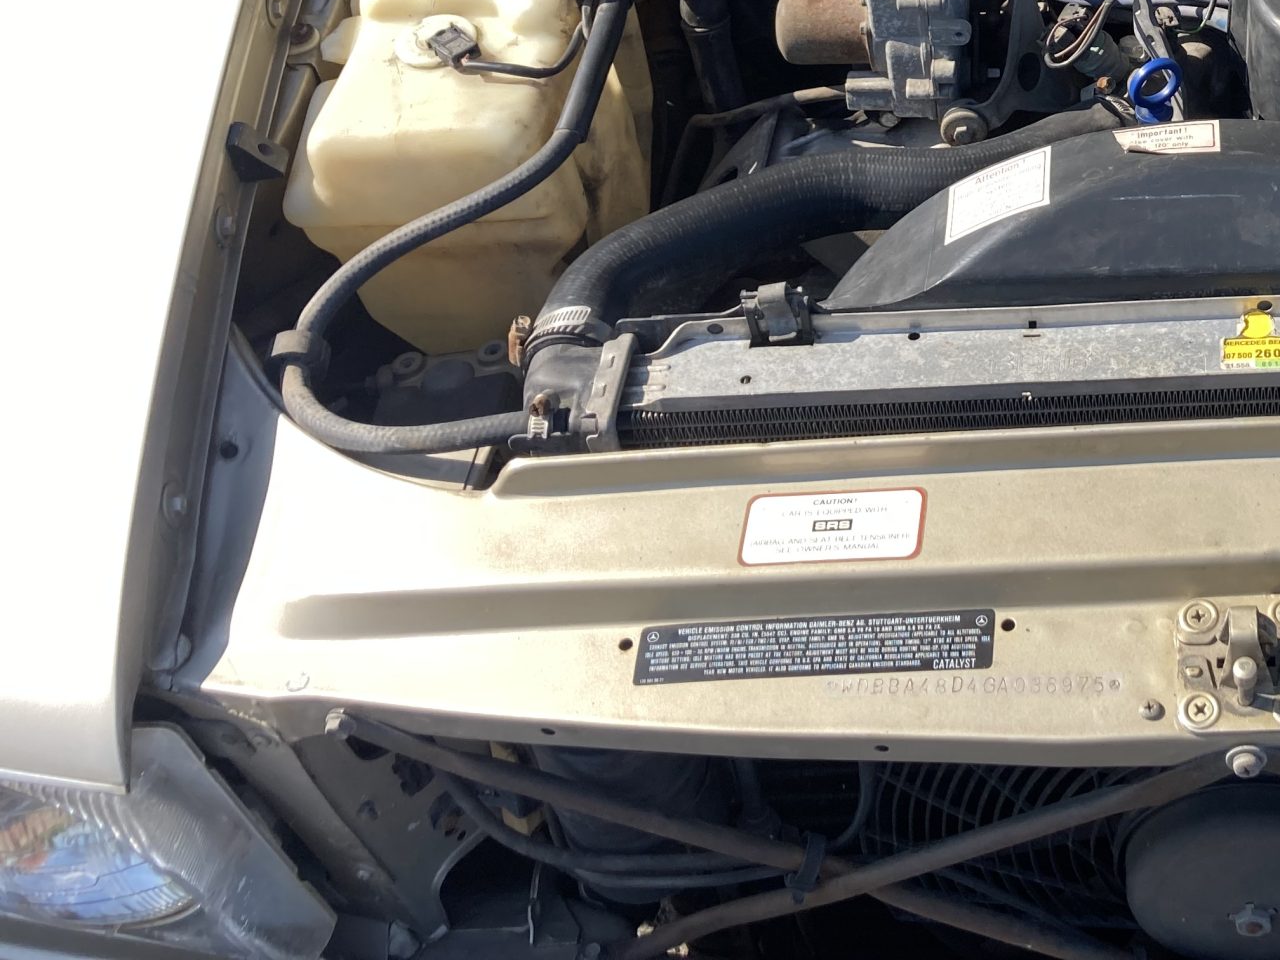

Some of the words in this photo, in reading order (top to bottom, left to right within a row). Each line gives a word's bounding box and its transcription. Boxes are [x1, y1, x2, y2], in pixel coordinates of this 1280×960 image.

[813, 520, 850, 530] SRS
[677, 626, 702, 635] VEHICLE
[703, 625, 734, 634] EMISSION
[735, 624, 763, 632] CONTROL
[764, 621, 807, 631] INFORMATION
[808, 619, 854, 629] DAIMLER-BENZ
[932, 657, 976, 669] CATALYST
